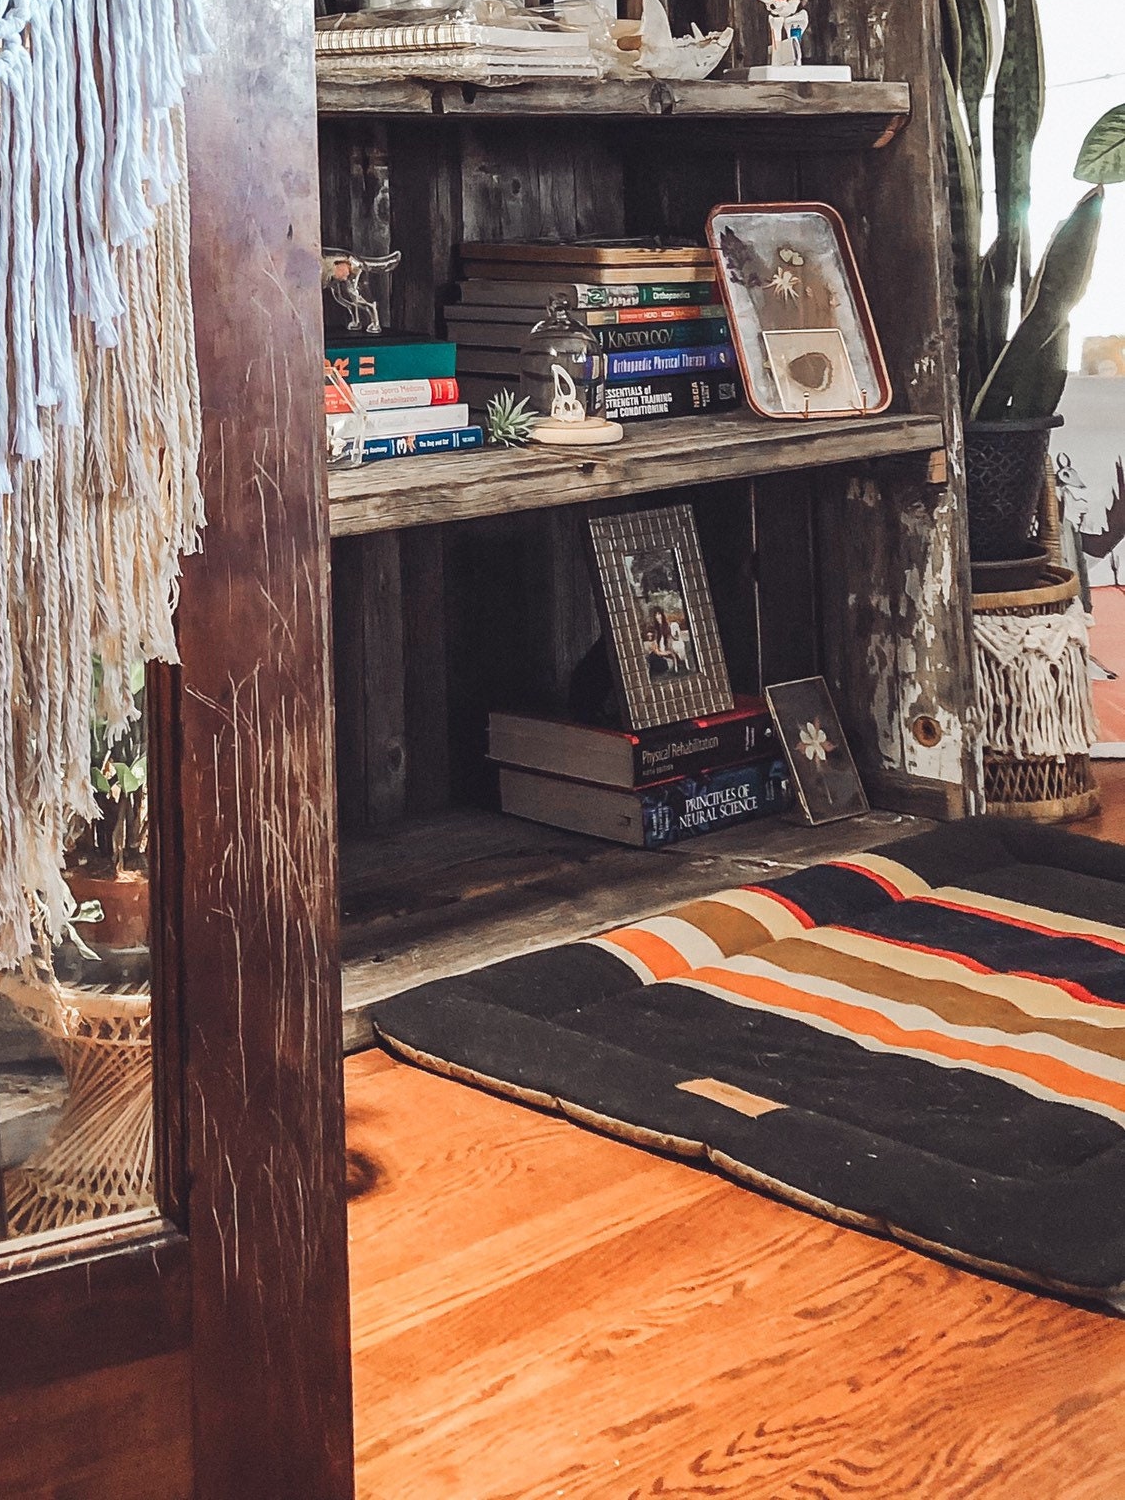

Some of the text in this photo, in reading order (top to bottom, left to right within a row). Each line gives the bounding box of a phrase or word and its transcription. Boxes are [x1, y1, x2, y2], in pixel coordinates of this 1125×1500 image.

[608, 328, 674, 349] KINESIOLOGY
[613, 353, 706, 374] Orthopaedic Physical Therapy
[605, 385, 652, 399] ESSENTIALS of
[605, 392, 673, 409] STRENGTH TRAINING
[606, 403, 669, 419] and CONDITIONING
[642, 744, 670, 767] Physical
[671, 736, 719, 758] Rehabilitation
[685, 786, 737, 814] PRINCIPLES
[737, 783, 750, 799] OF
[679, 806, 718, 829] NEURAL
[719, 796, 758, 817] SCIENCE
